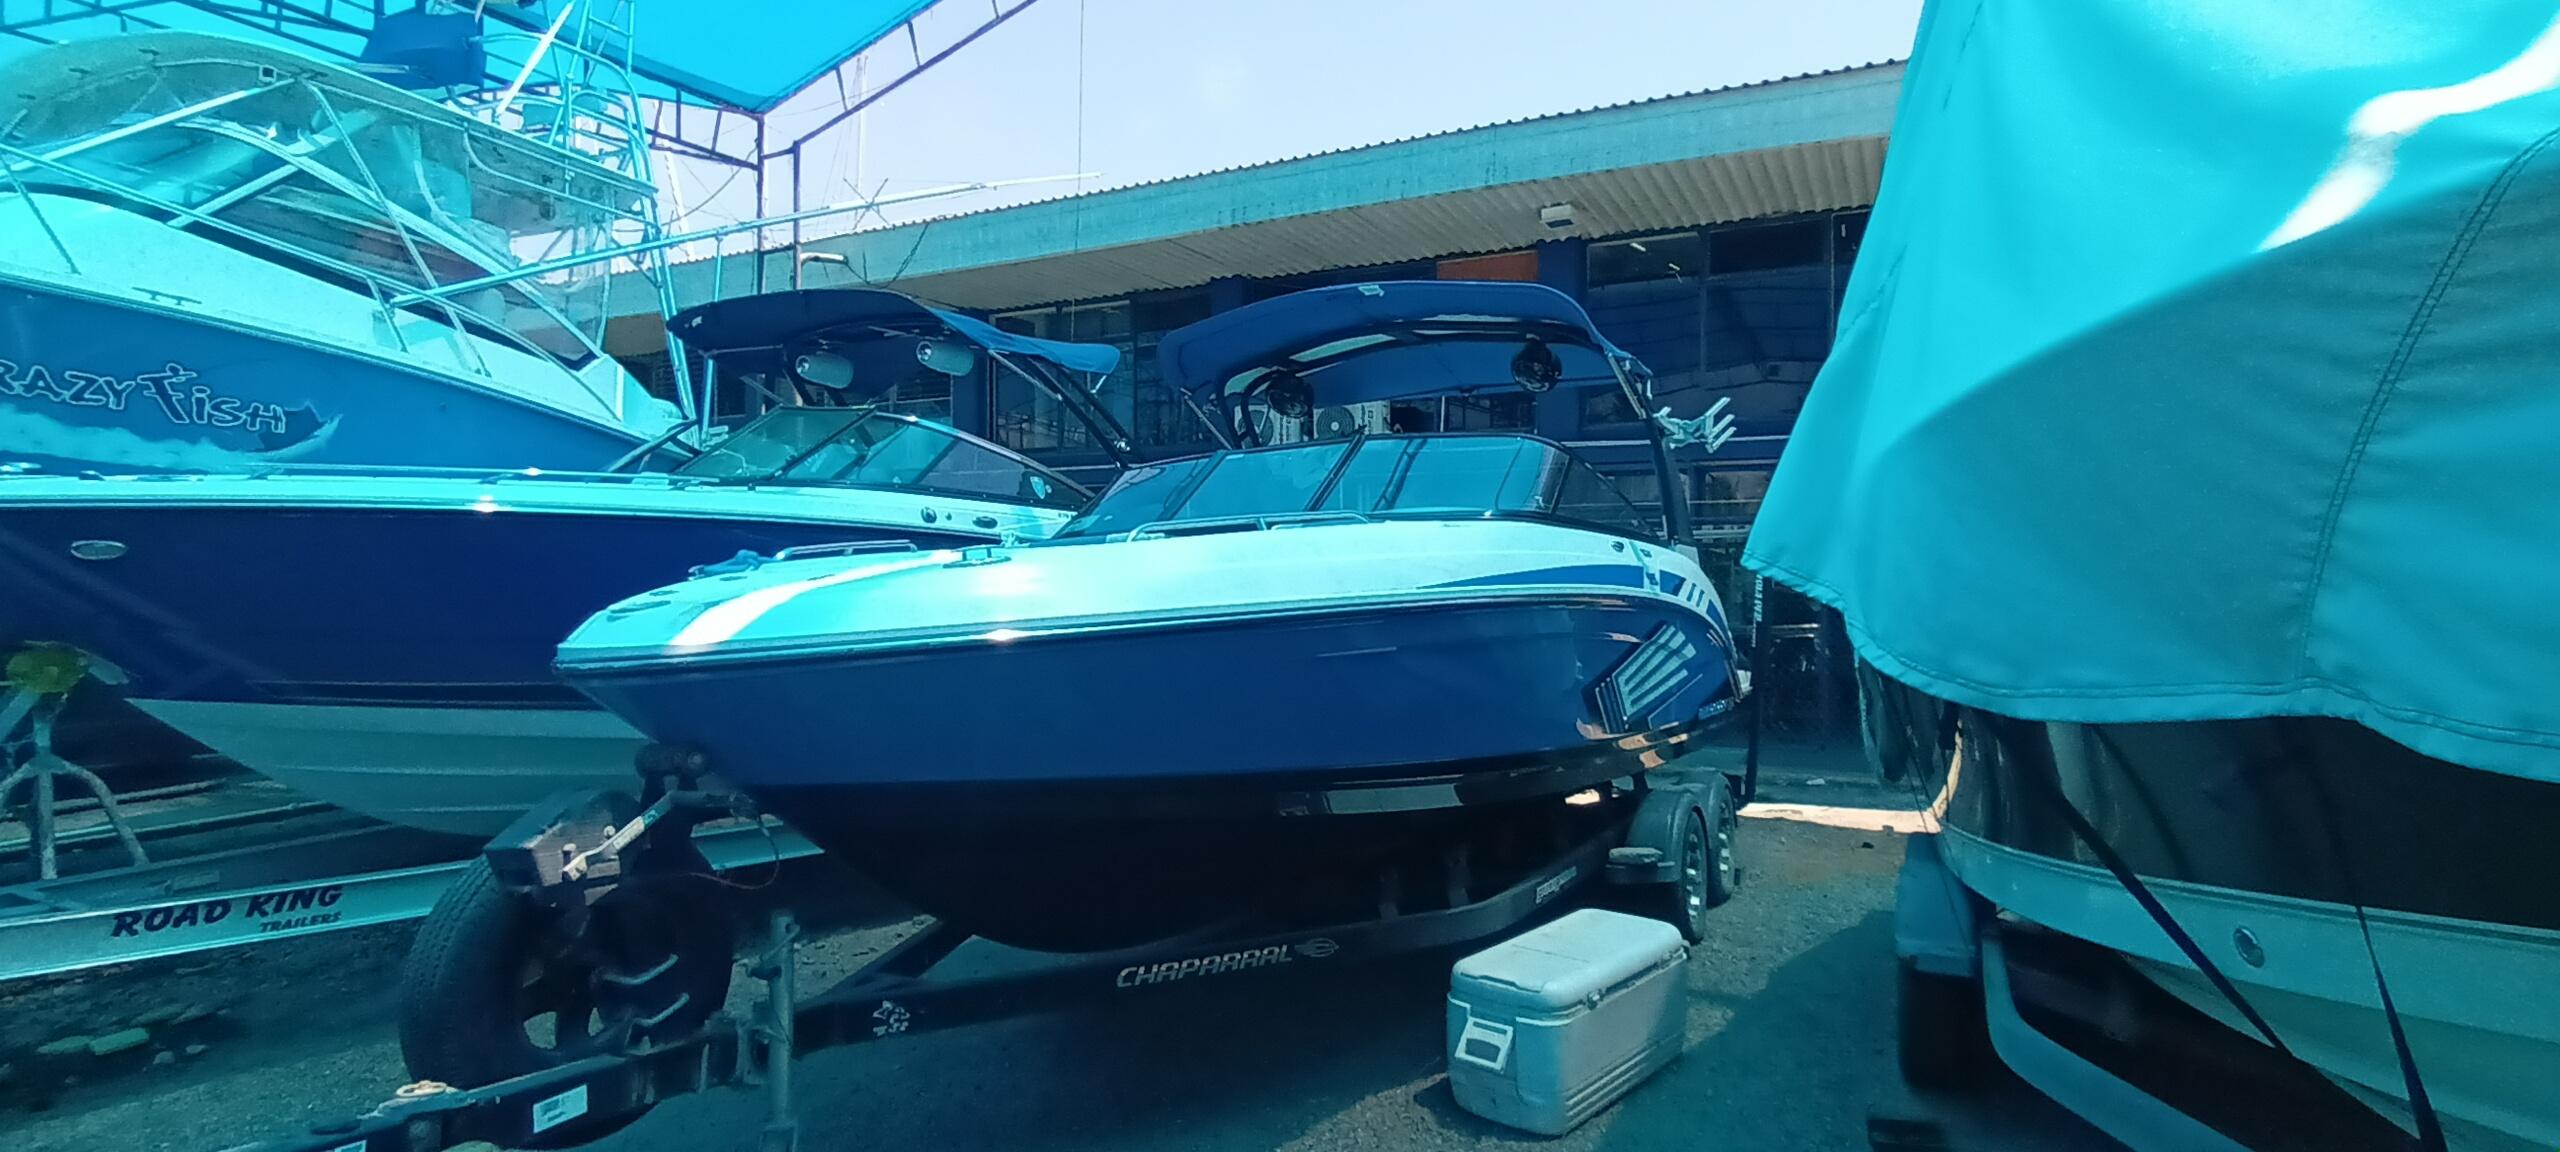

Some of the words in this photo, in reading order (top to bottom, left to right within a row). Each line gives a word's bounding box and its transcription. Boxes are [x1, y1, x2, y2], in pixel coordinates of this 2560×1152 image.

[110, 898, 231, 937] ROAD
[245, 885, 343, 918] KING
[259, 911, 342, 933] TRAILERS
[1116, 944, 1292, 987] CHAPARRAL
